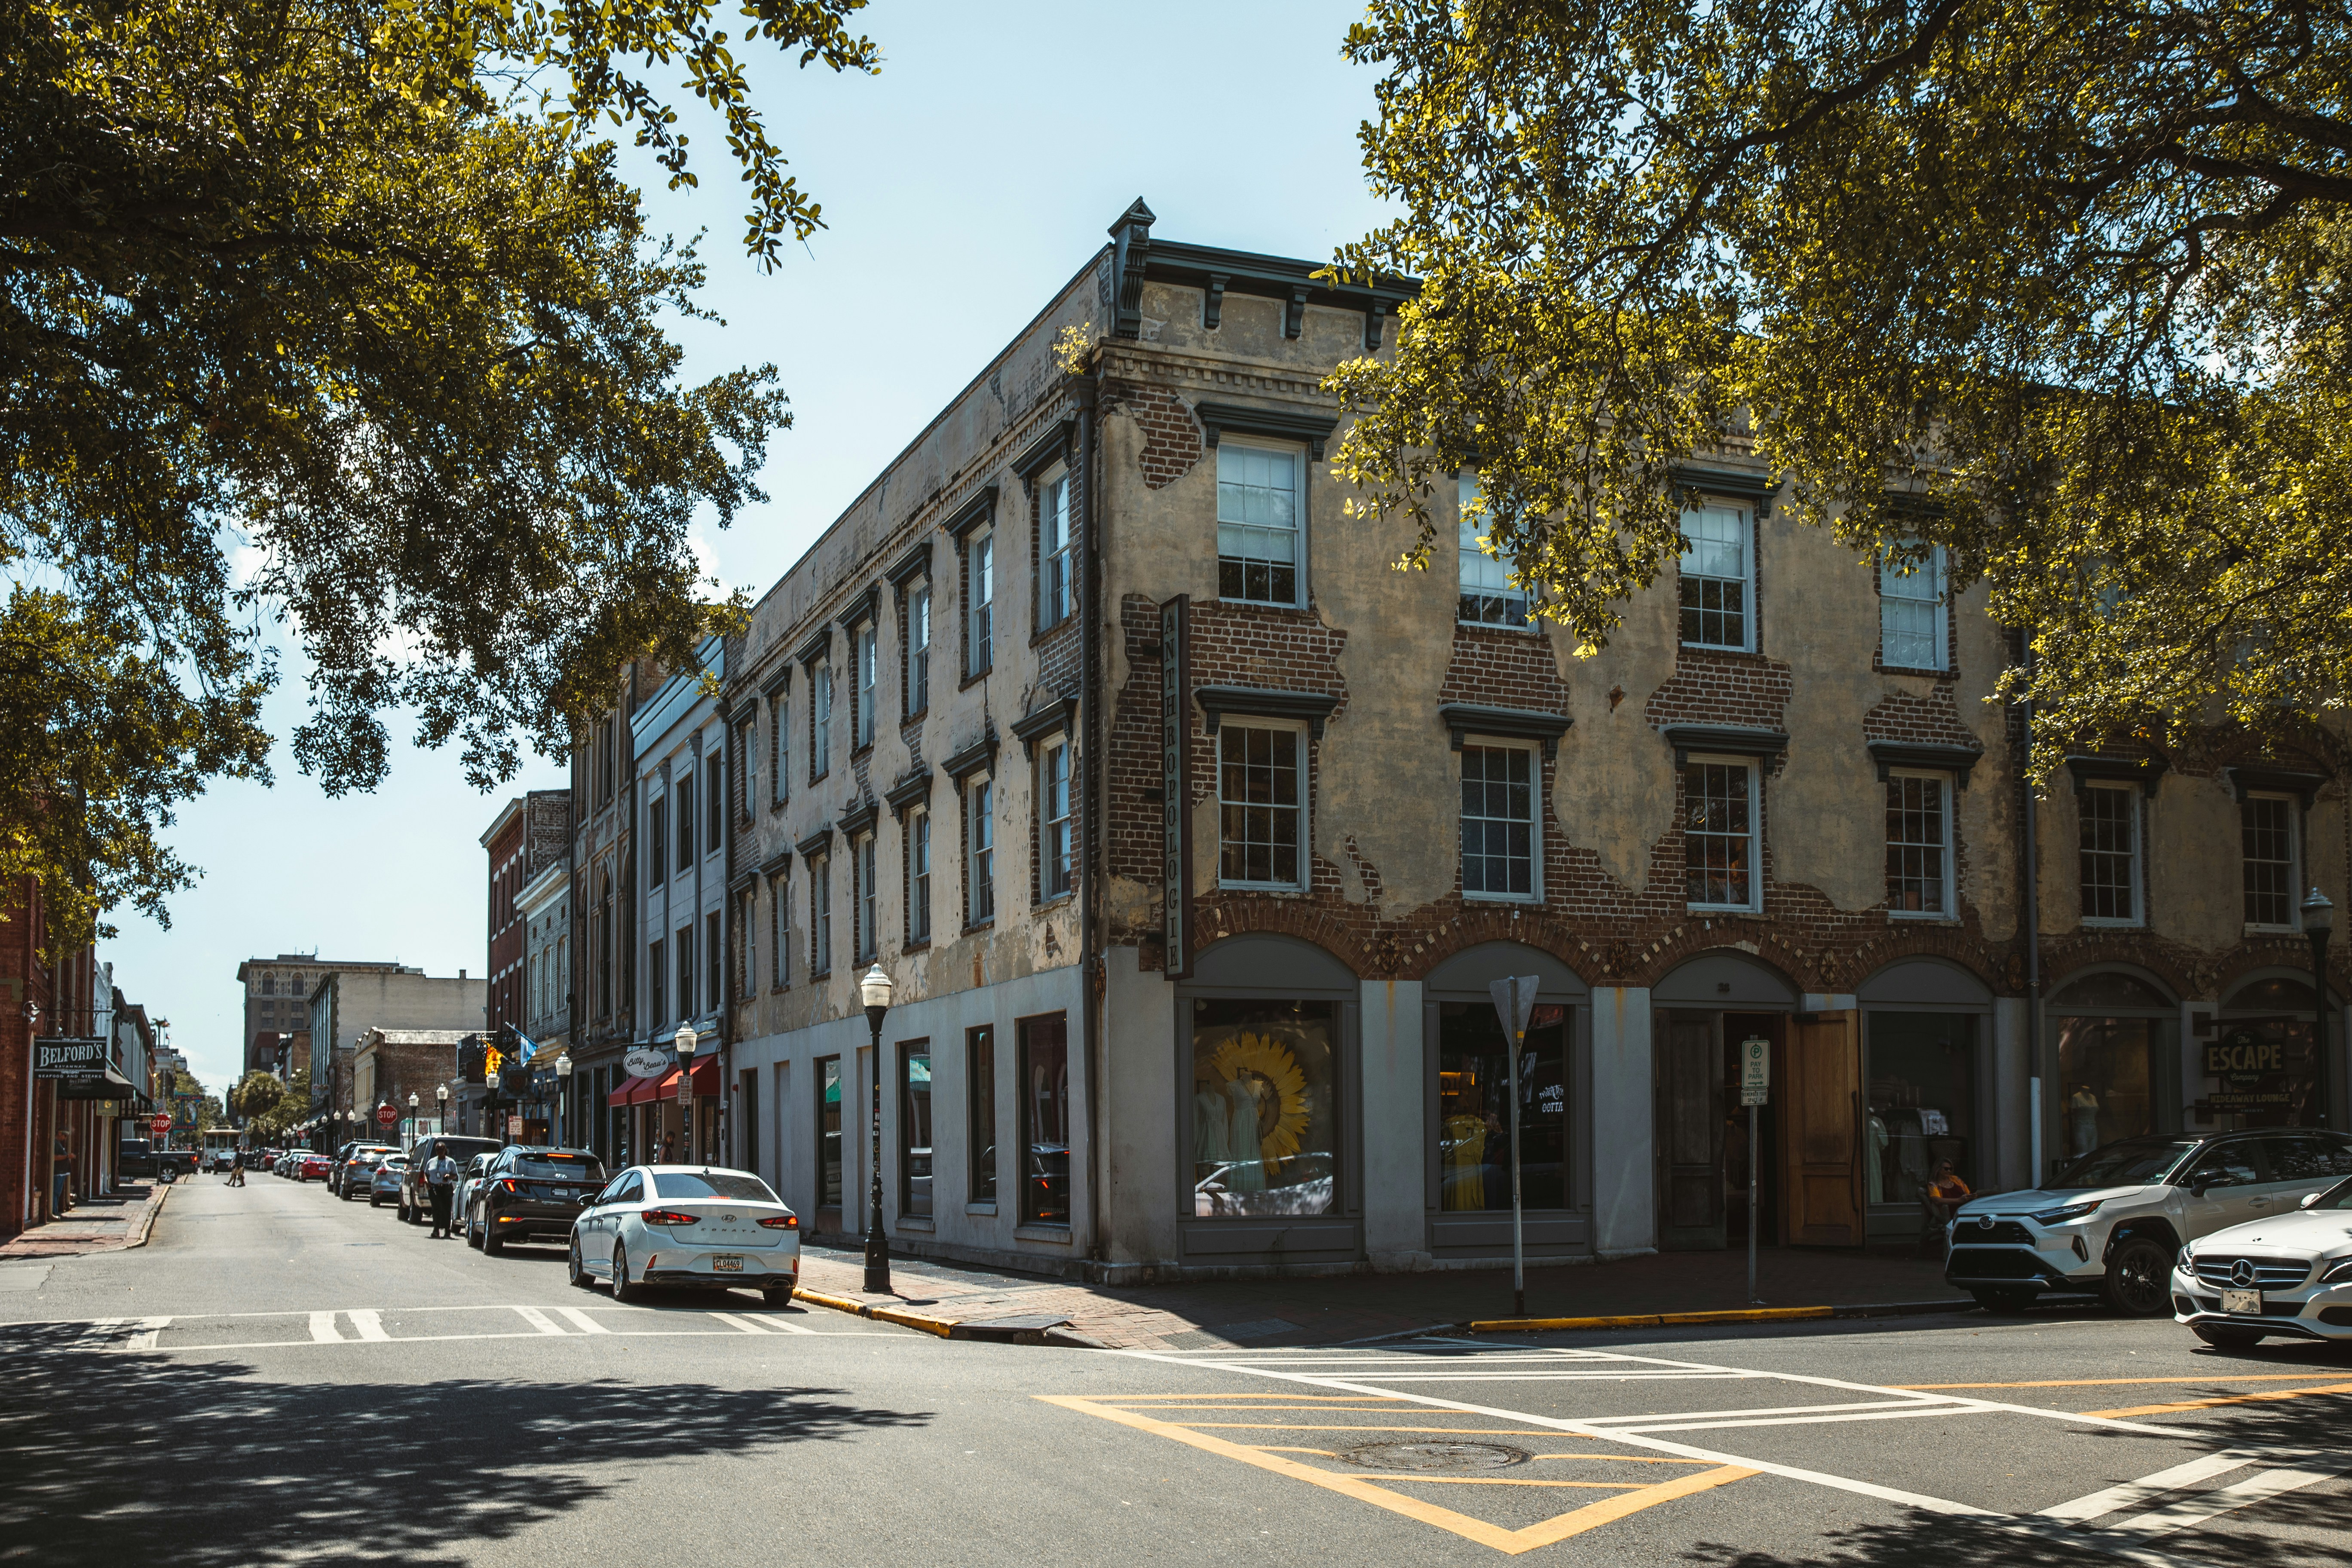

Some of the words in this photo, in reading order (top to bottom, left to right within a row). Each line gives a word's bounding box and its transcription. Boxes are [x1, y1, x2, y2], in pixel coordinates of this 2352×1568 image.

[1164, 611, 1179, 968] ANTHROPOLOGIE
[39, 1043, 103, 1068] BELFORD'S
[627, 1056, 644, 1066] Bitty
[643, 1059, 666, 1070] Beau's
[2208, 1044, 2282, 1071] ESCAPE
[2230, 1073, 2260, 1082] Company
[2210, 1094, 2255, 1103] HIDEAWAY
[2256, 1093, 2290, 1102] LOUNGE
